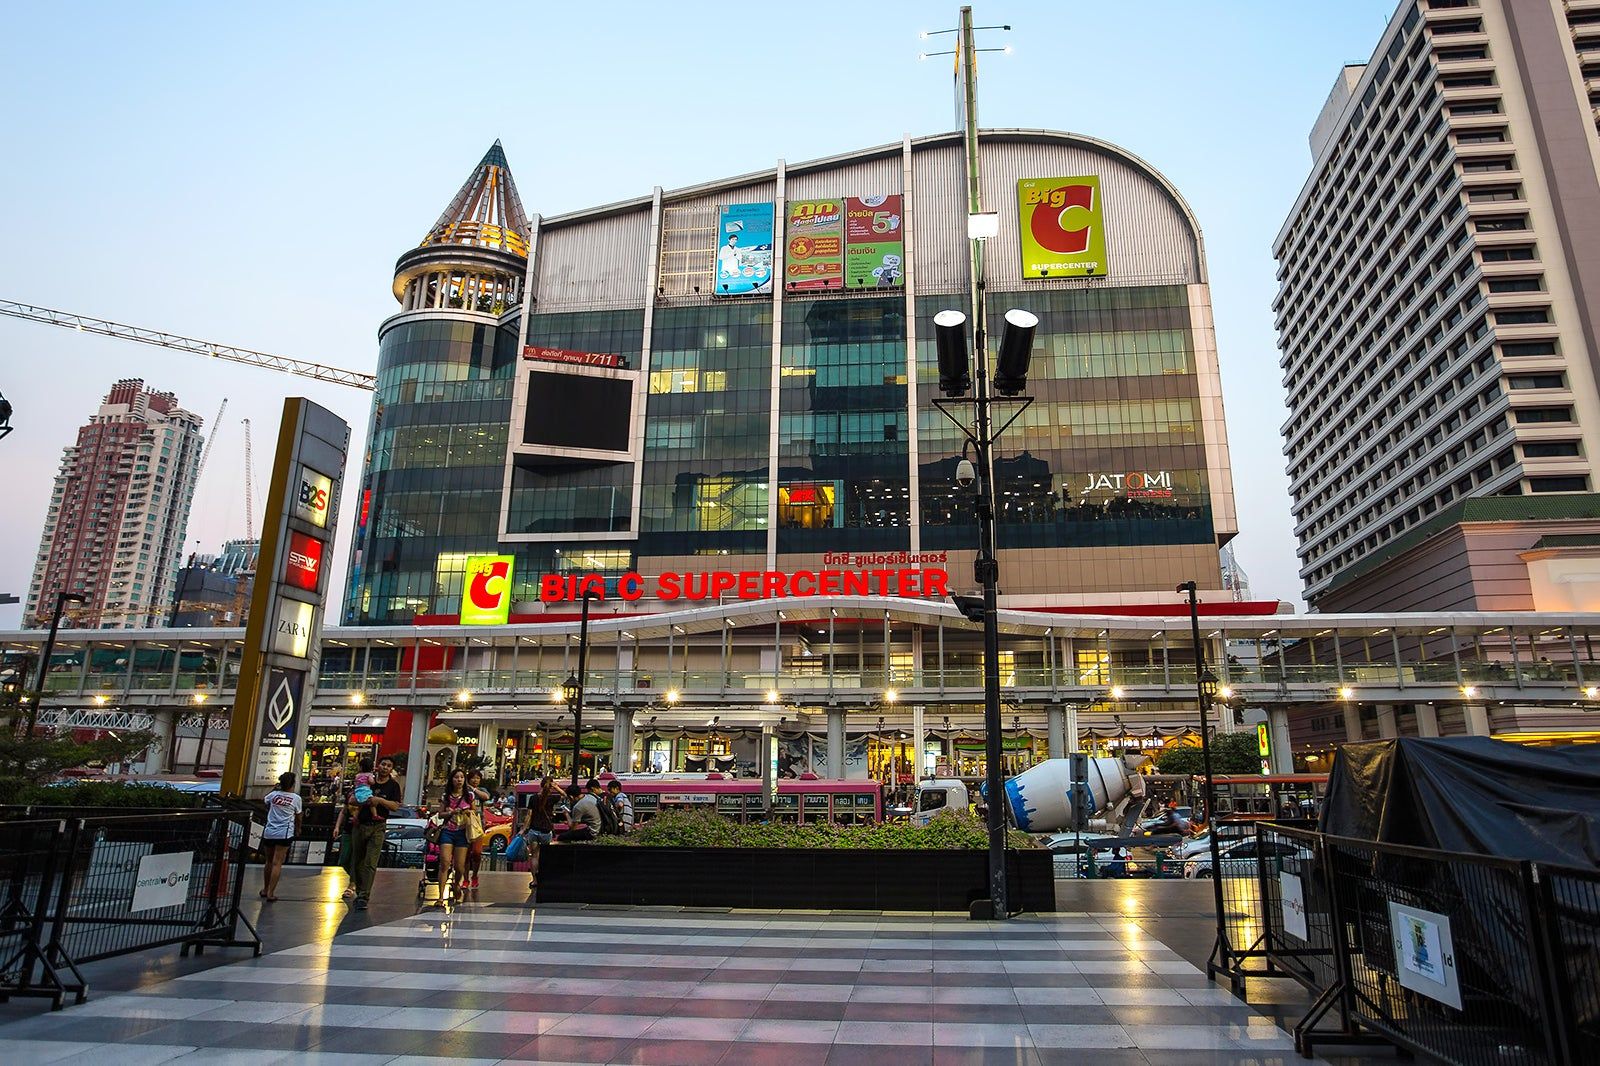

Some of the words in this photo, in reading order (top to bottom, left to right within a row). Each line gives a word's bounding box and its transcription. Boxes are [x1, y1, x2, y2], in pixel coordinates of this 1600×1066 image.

[1026, 188, 1066, 208] Big
[872, 211, 893, 234] 5
[1030, 184, 1094, 255] C
[1031, 261, 1098, 271] SUPERCENTER
[585, 353, 612, 365] 1711
[1085, 471, 1171, 490] JATOMI
[300, 480, 327, 511] B2S
[1127, 490, 1172, 498] FITNESS
[470, 561, 510, 611] C
[541, 573, 605, 602] BIG
[617, 571, 645, 601] C
[656, 568, 949, 600] SUPERCENTER
[136, 871, 190, 888] centralworld
